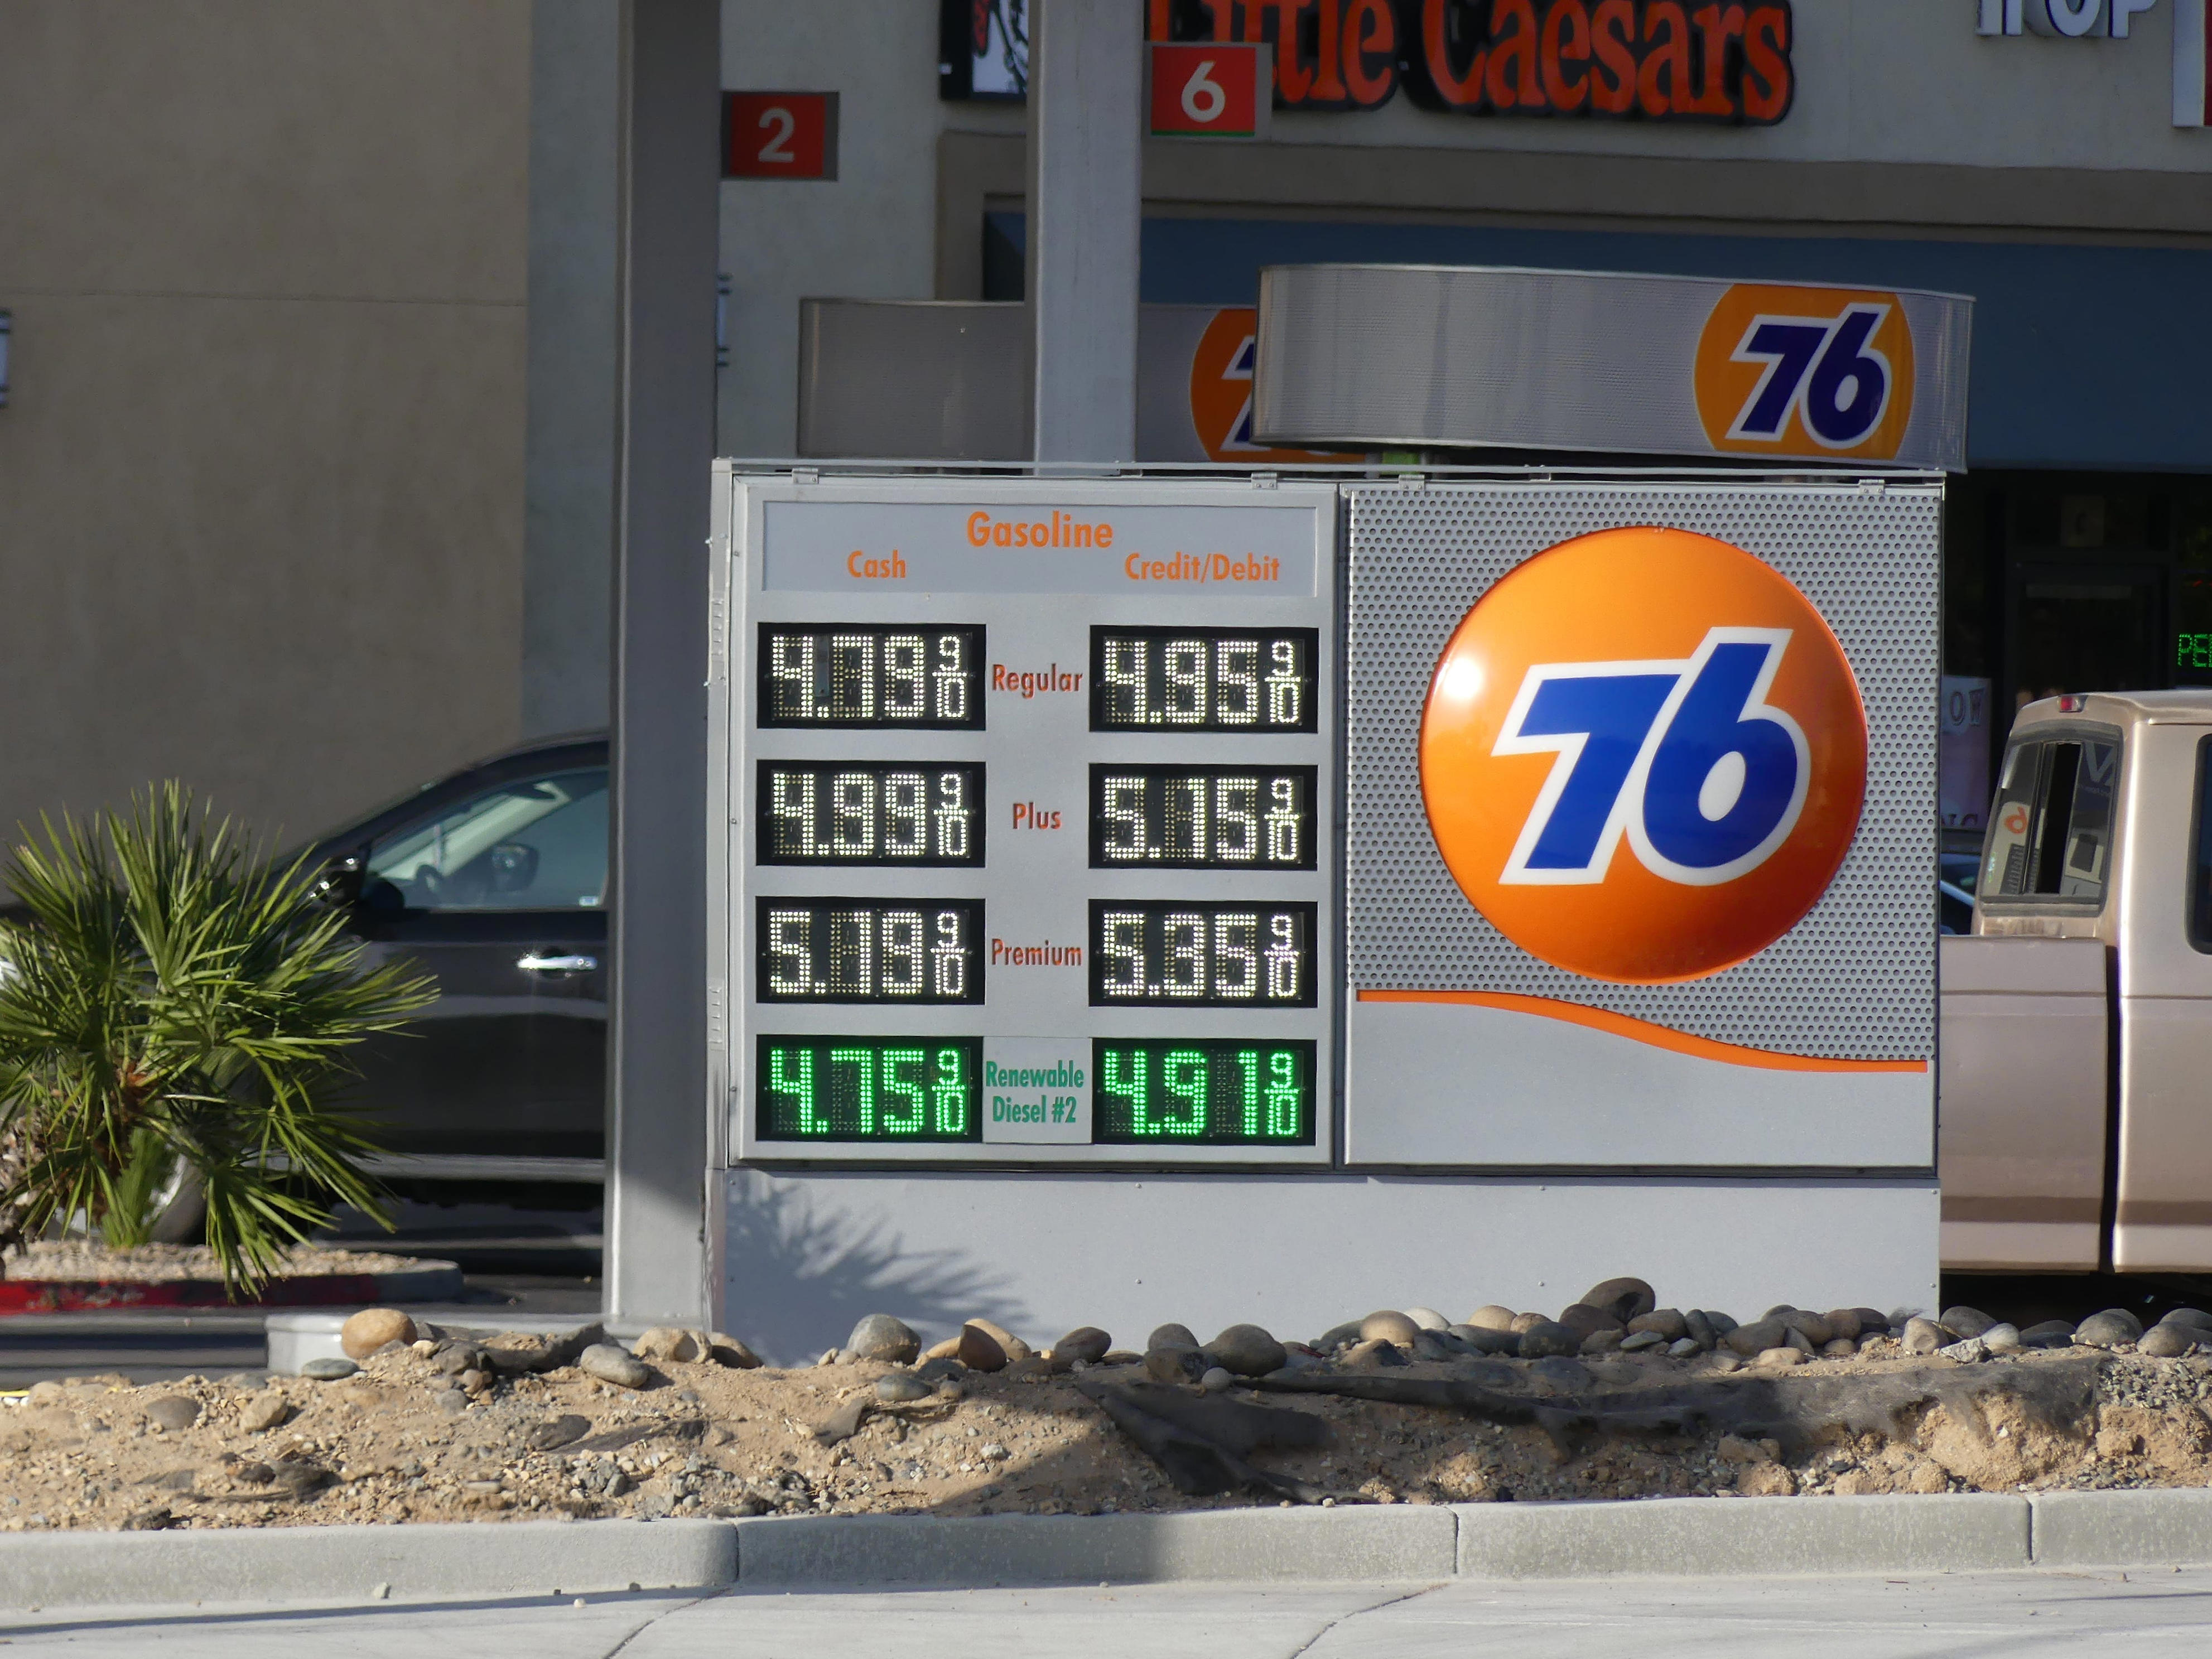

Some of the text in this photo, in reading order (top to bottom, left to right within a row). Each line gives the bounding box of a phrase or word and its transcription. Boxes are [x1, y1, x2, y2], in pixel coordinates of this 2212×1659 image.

[1181, 61, 1225, 122] 6
[1422, 0, 1789, 119] Caesars
[759, 108, 795, 162] 2
[1725, 302, 1892, 450] 76
[847, 549, 907, 578] Cash
[966, 510, 1114, 548] Gasoline
[1124, 551, 1280, 583] Credit/Debit
[772, 635, 924, 718] 4.79
[992, 663, 1083, 699] Regular
[1105, 640, 1258, 724] 4.95
[2178, 634, 2212, 667] PE
[1491, 627, 1811, 886] 76
[773, 773, 926, 855] 4.99
[1013, 802, 1062, 830] Plus
[1104, 778, 1257, 860] 5.15
[770, 912, 923, 994] 5.19
[991, 938, 1082, 967] Premium
[1103, 913, 1256, 996] 5.35
[770, 1049, 924, 1132] 4.75
[986, 1060, 1085, 1088] Renewable
[992, 1094, 1077, 1123] Diesel #2
[1105, 1052, 1257, 1135] 4.91
